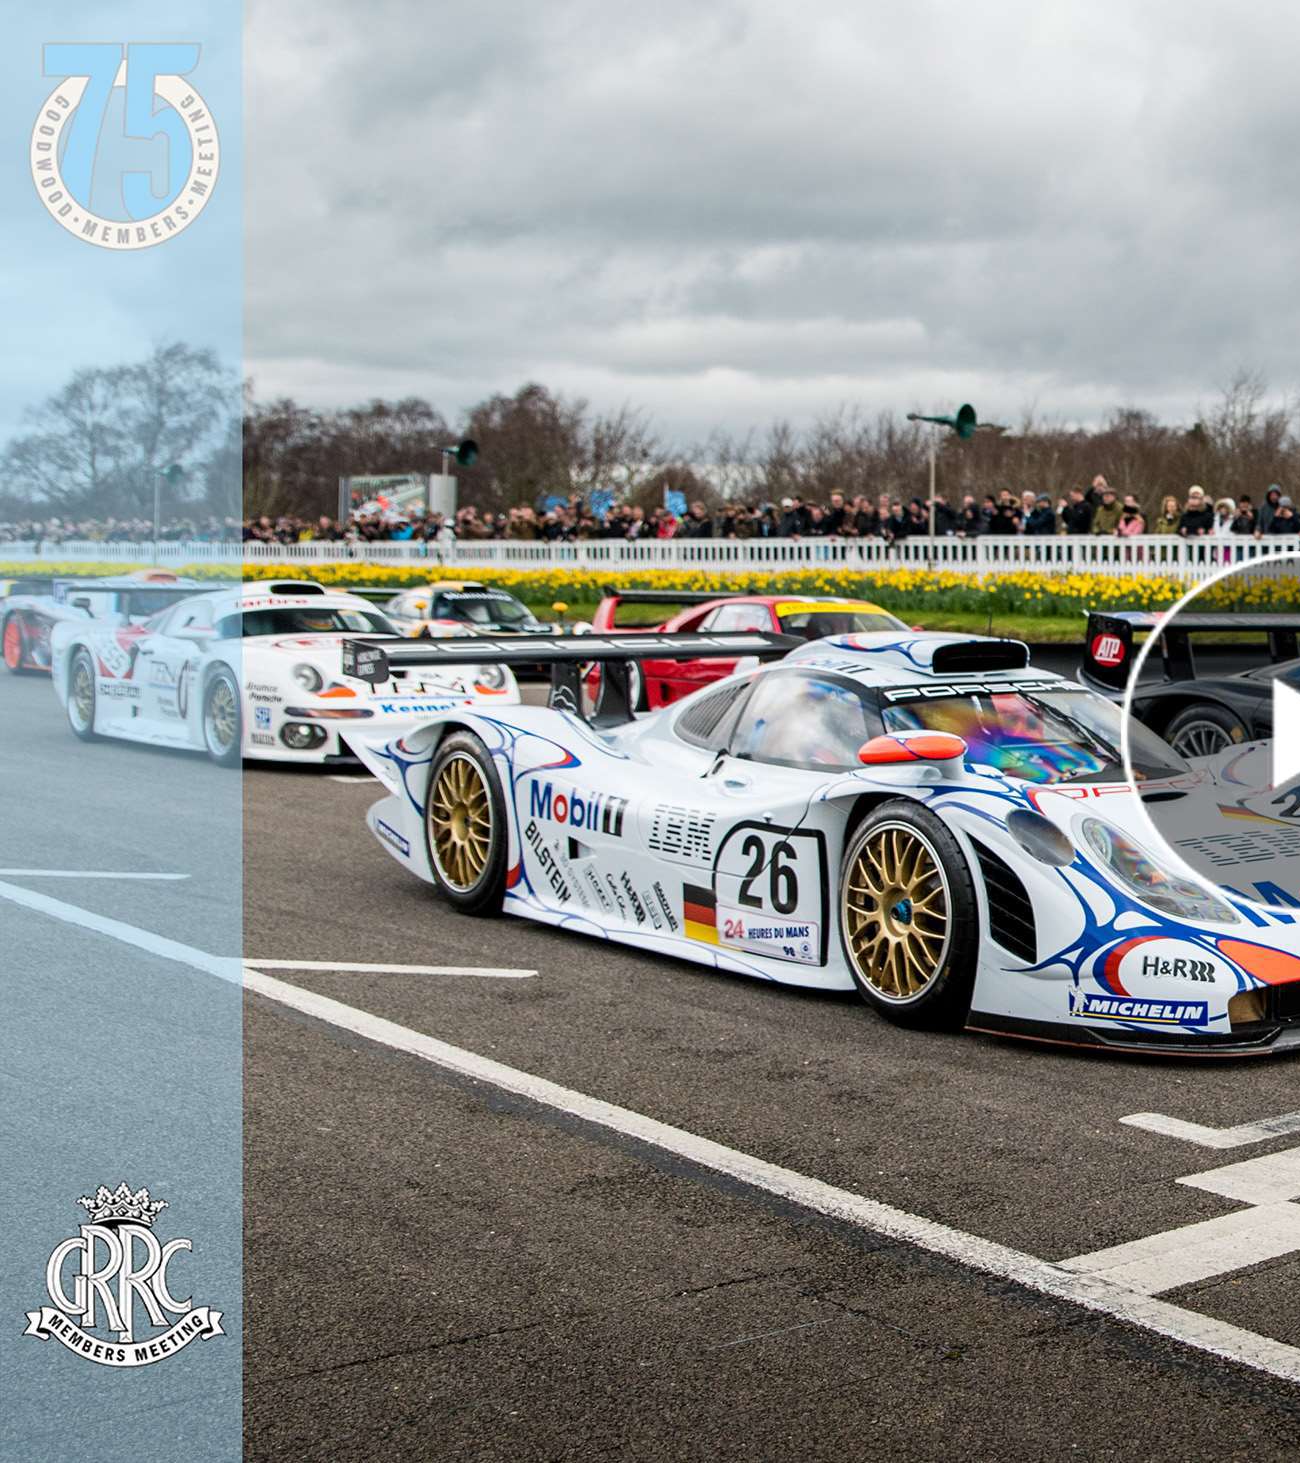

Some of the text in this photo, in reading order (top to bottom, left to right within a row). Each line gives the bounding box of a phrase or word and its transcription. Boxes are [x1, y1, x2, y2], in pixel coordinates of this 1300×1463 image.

[1097, 637, 1121, 658] ATP
[884, 680, 1091, 702] PORSCHE
[530, 779, 603, 831] Mobil
[649, 804, 717, 861] IBM
[525, 820, 571, 903] BILSTEIN
[738, 835, 799, 915] 26
[724, 919, 810, 939] 24 HEURES DU MANS
[1088, 998, 1204, 1020] MICHELIN
